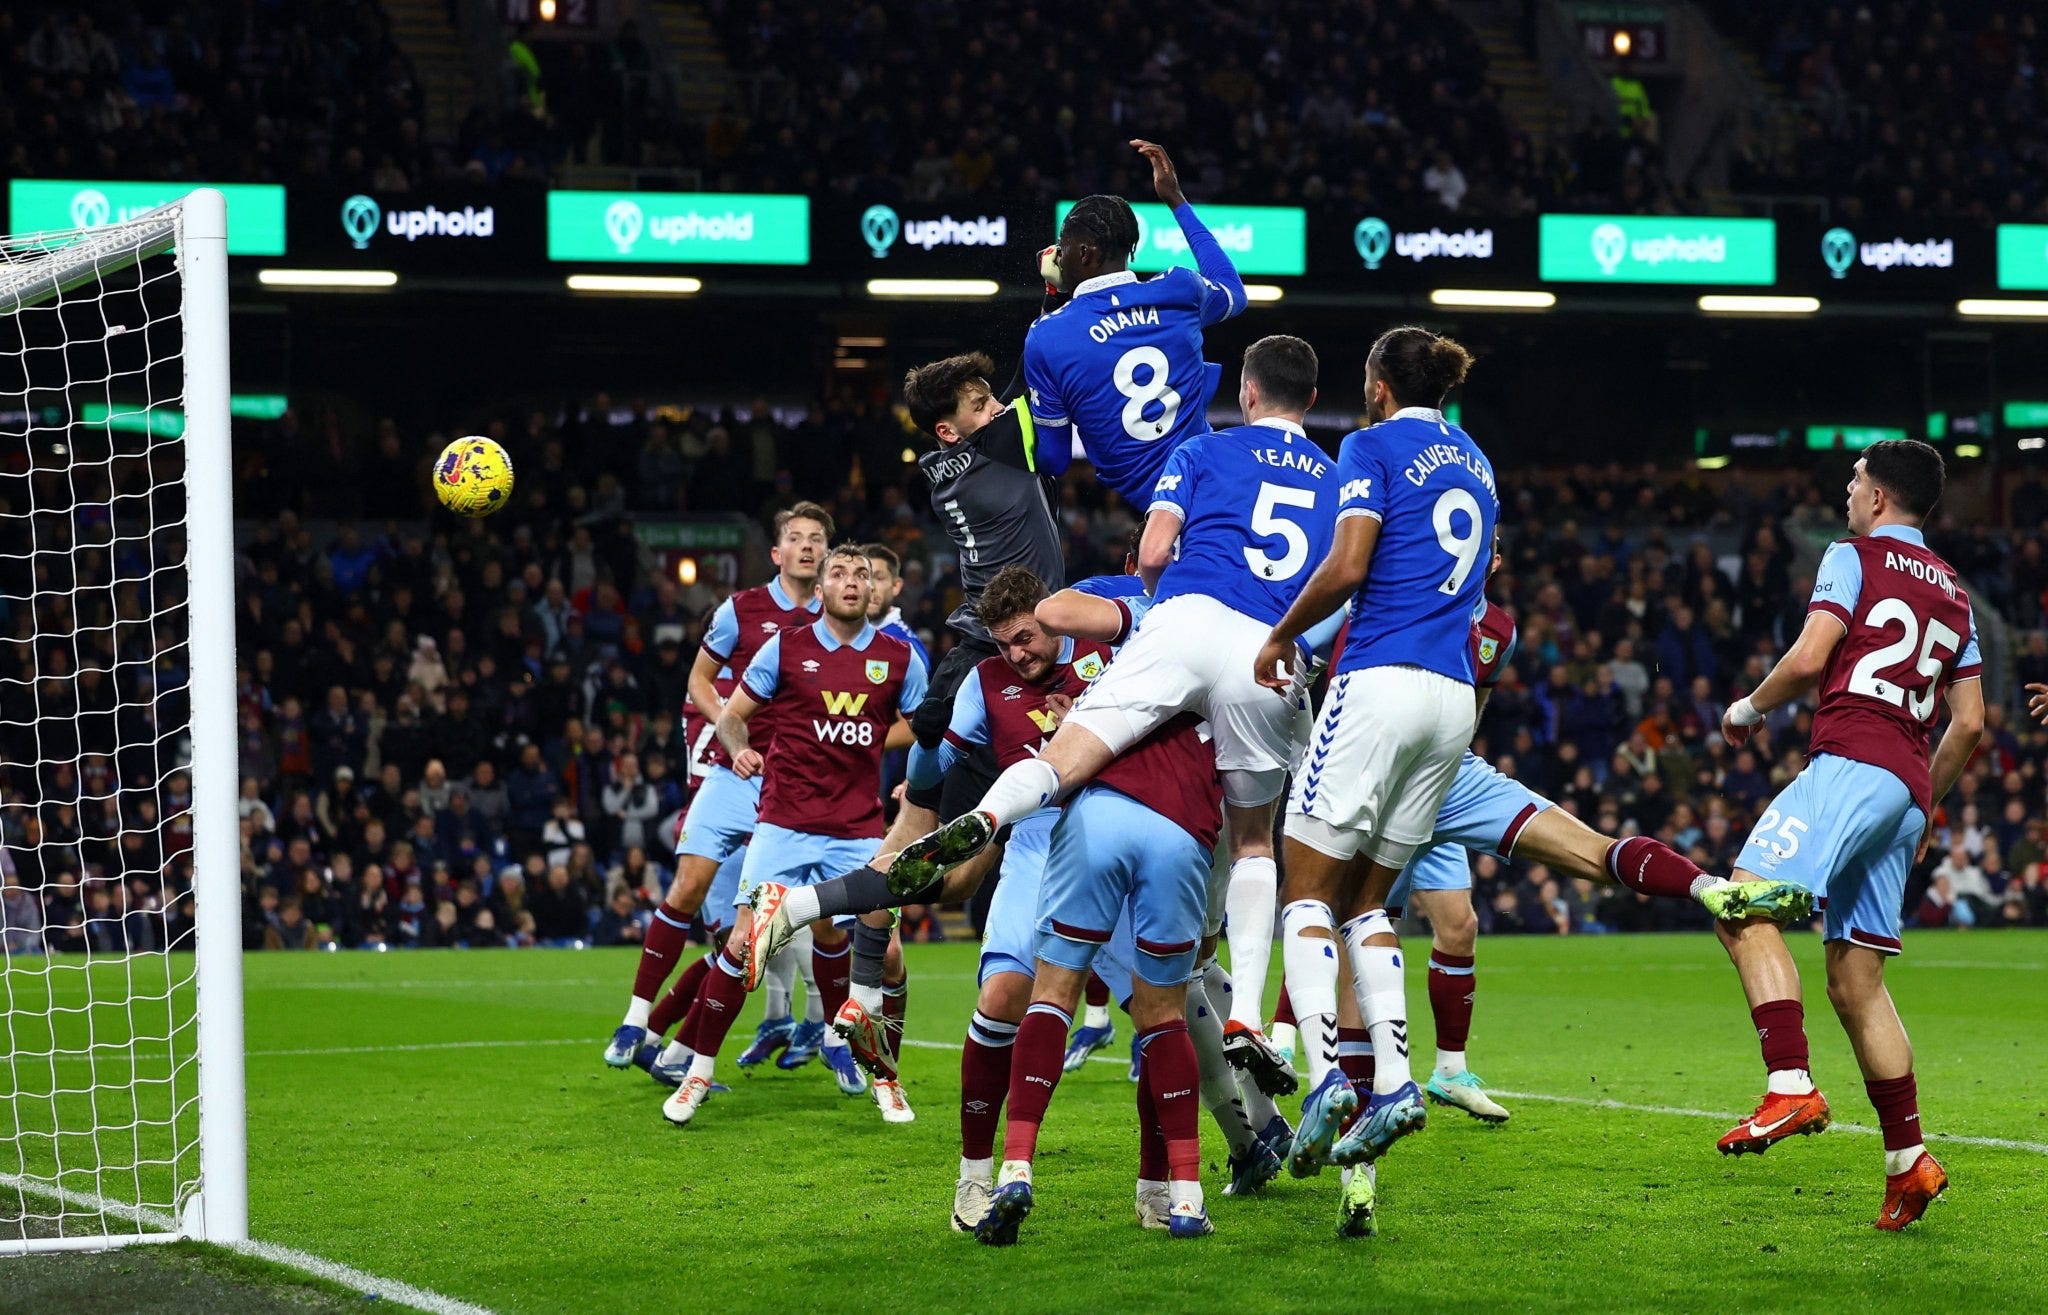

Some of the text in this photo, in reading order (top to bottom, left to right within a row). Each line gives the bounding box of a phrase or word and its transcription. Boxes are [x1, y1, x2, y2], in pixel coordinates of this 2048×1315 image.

[1638, 29, 1658, 57] 3
[388, 206, 493, 241] uphold
[649, 212, 753, 246] uphold
[905, 216, 1006, 250] uphold
[1153, 223, 1253, 256] upold
[1396, 228, 1493, 262] uphold
[1630, 233, 1727, 267] uphold
[1860, 237, 1953, 271] uphold
[1089, 306, 1159, 343] ONANA
[1113, 345, 1181, 441] 8
[1251, 448, 1326, 479] KEANE
[1243, 480, 1315, 581] 5
[1432, 487, 1482, 595] 9
[1848, 597, 1960, 722] 25
[812, 719, 873, 747] W88
[1750, 808, 1808, 859] 25
[1025, 1075, 1052, 1088] BFC
[1162, 1089, 1191, 1099] BFC
